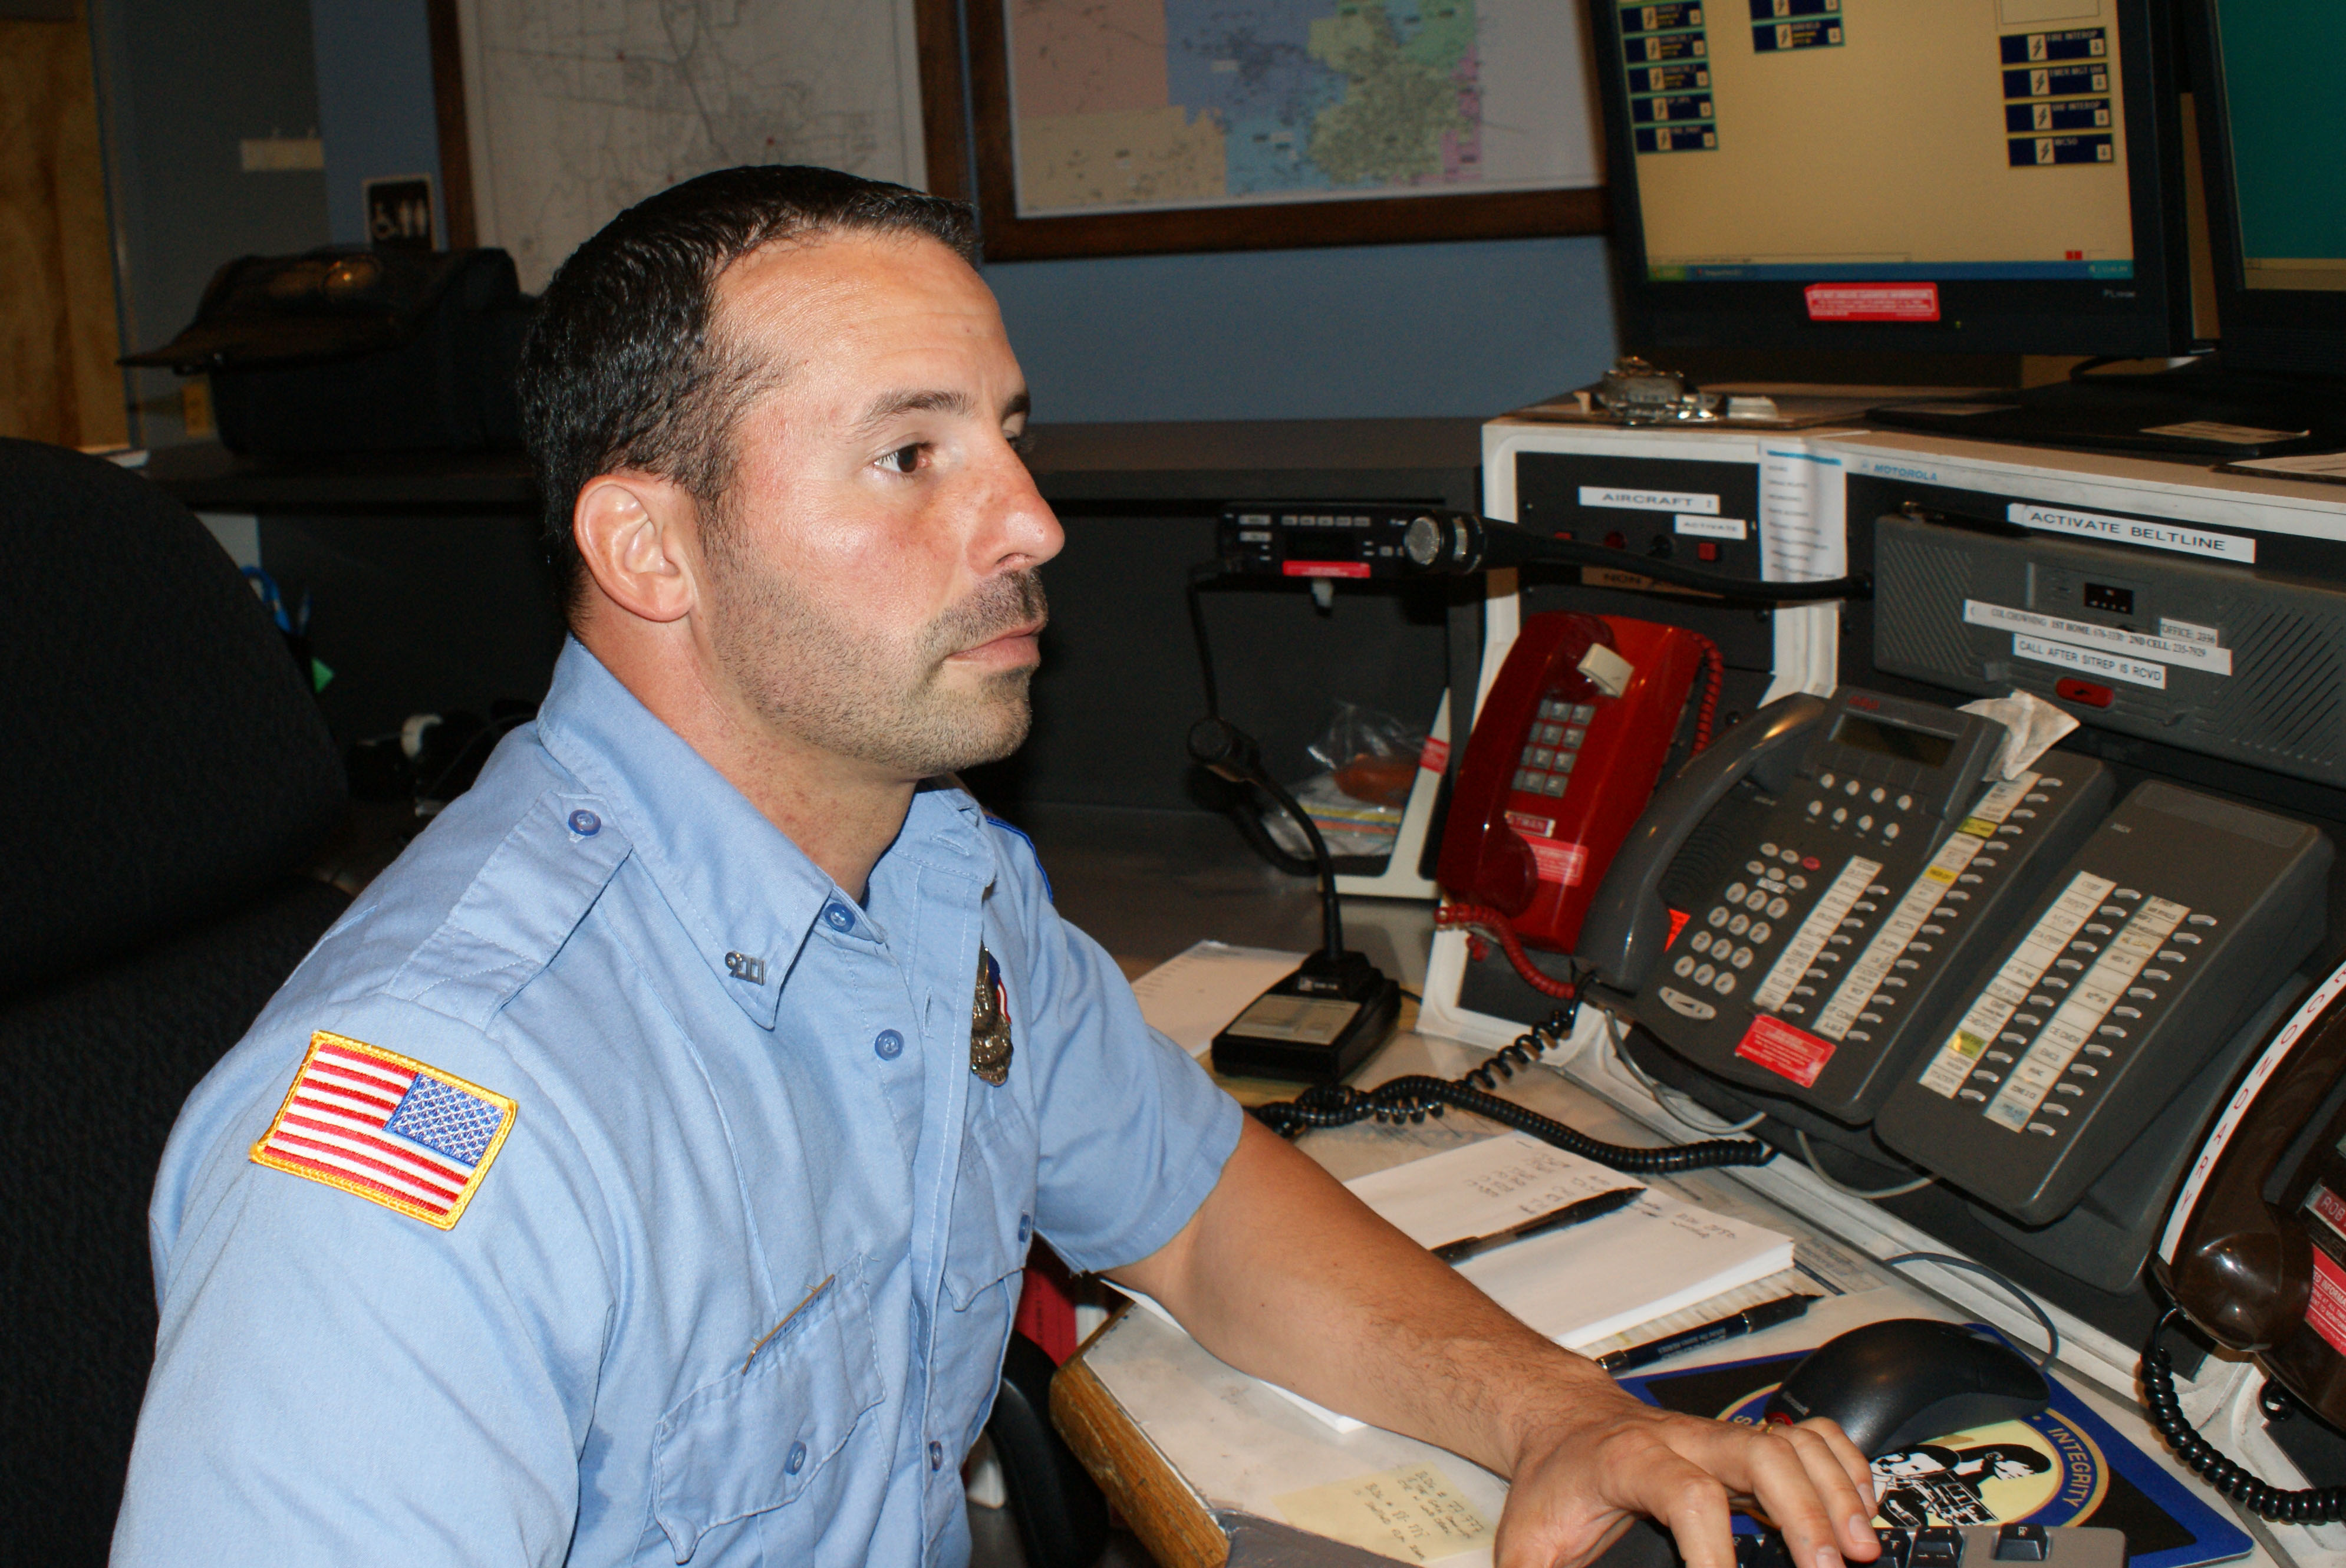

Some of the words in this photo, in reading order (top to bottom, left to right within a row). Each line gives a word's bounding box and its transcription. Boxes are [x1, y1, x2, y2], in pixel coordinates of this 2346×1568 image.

[1873, 463, 1938, 481] MOTOROLA
[1602, 493, 1692, 507] AIRCRAFT
[1683, 520, 1737, 532] ACTIVATE
[2030, 512, 2120, 534] ACTIVATE
[2130, 526, 2226, 551] BELTLINE
[2128, 635, 2145, 645] 2ND
[2019, 640, 2044, 655] CALL
[2048, 648, 2078, 662] AFTER
[2081, 654, 2116, 669] SITREP
[2120, 664, 2128, 674] IS
[2132, 666, 2161, 681] RCVD
[2321, 1196, 2345, 1221] ROB
[2047, 1427, 2092, 1508] INTEGRITY
